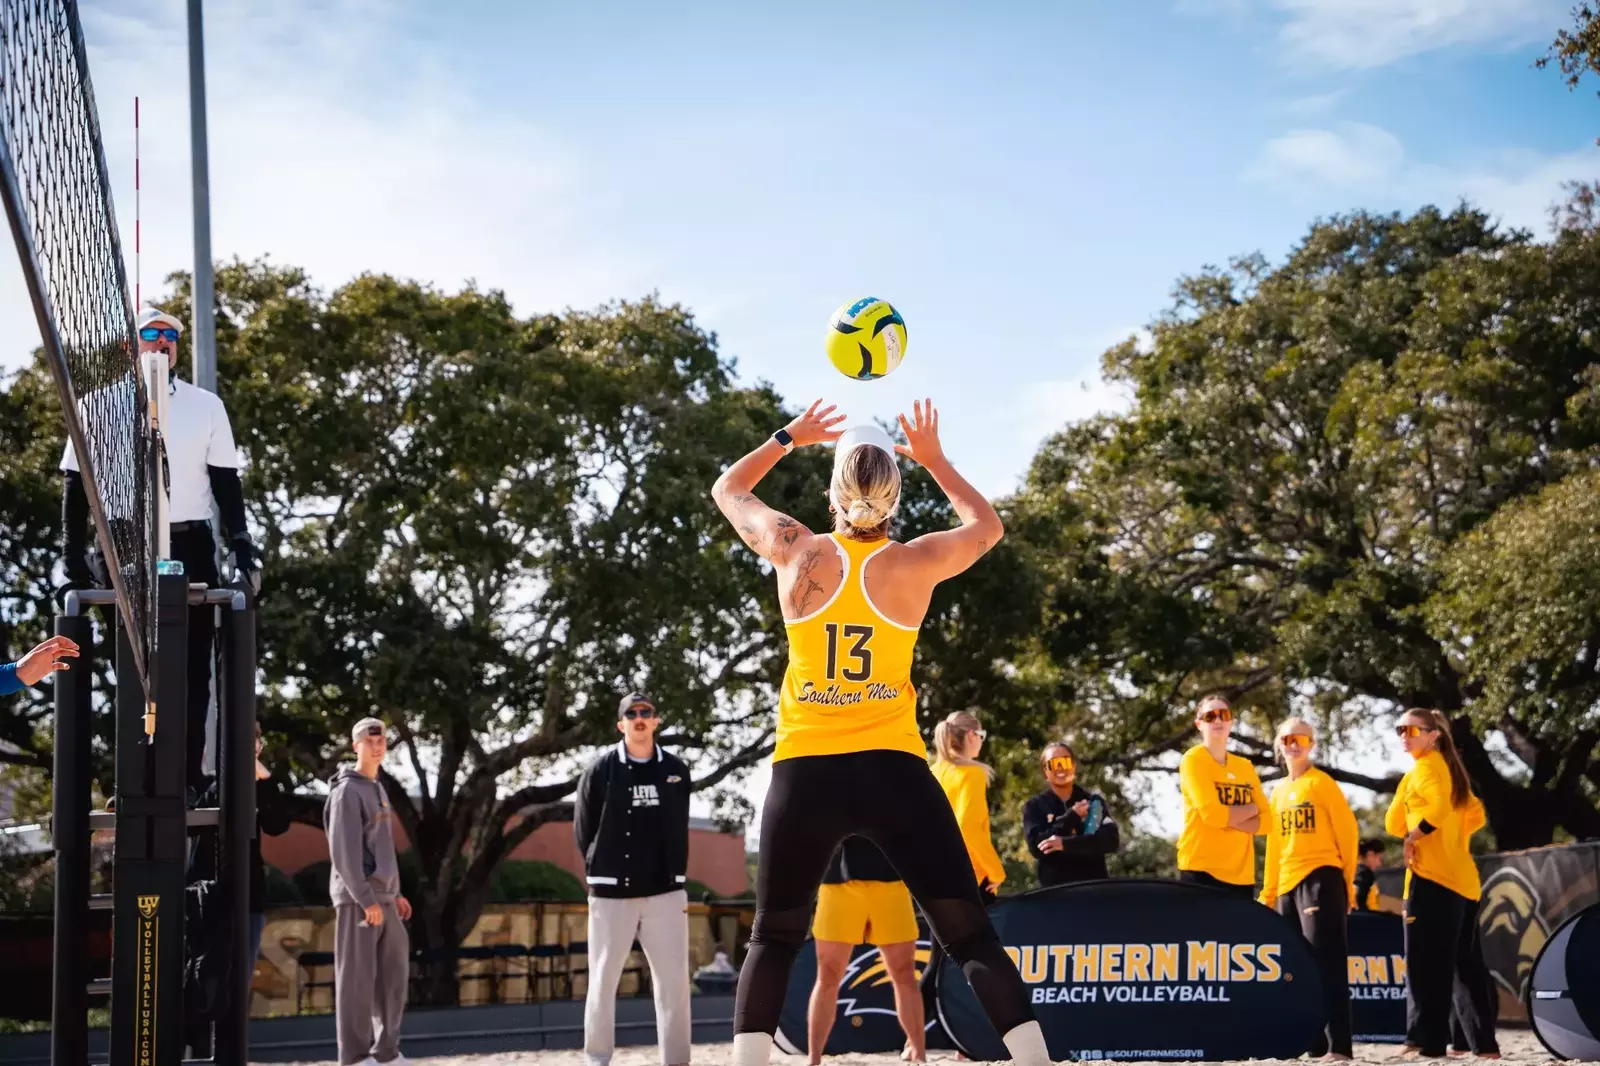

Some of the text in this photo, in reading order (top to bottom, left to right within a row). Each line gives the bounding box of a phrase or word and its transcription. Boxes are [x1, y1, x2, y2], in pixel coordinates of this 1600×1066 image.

[825, 623, 874, 682] 13
[798, 681, 899, 706] Southern Miss
[1002, 940, 1282, 984] UTHERN MISS
[1031, 985, 1230, 1004] BEACH VOLLEYBALL
[1105, 1049, 1204, 1058] @SOUTHERNMISSBVB
